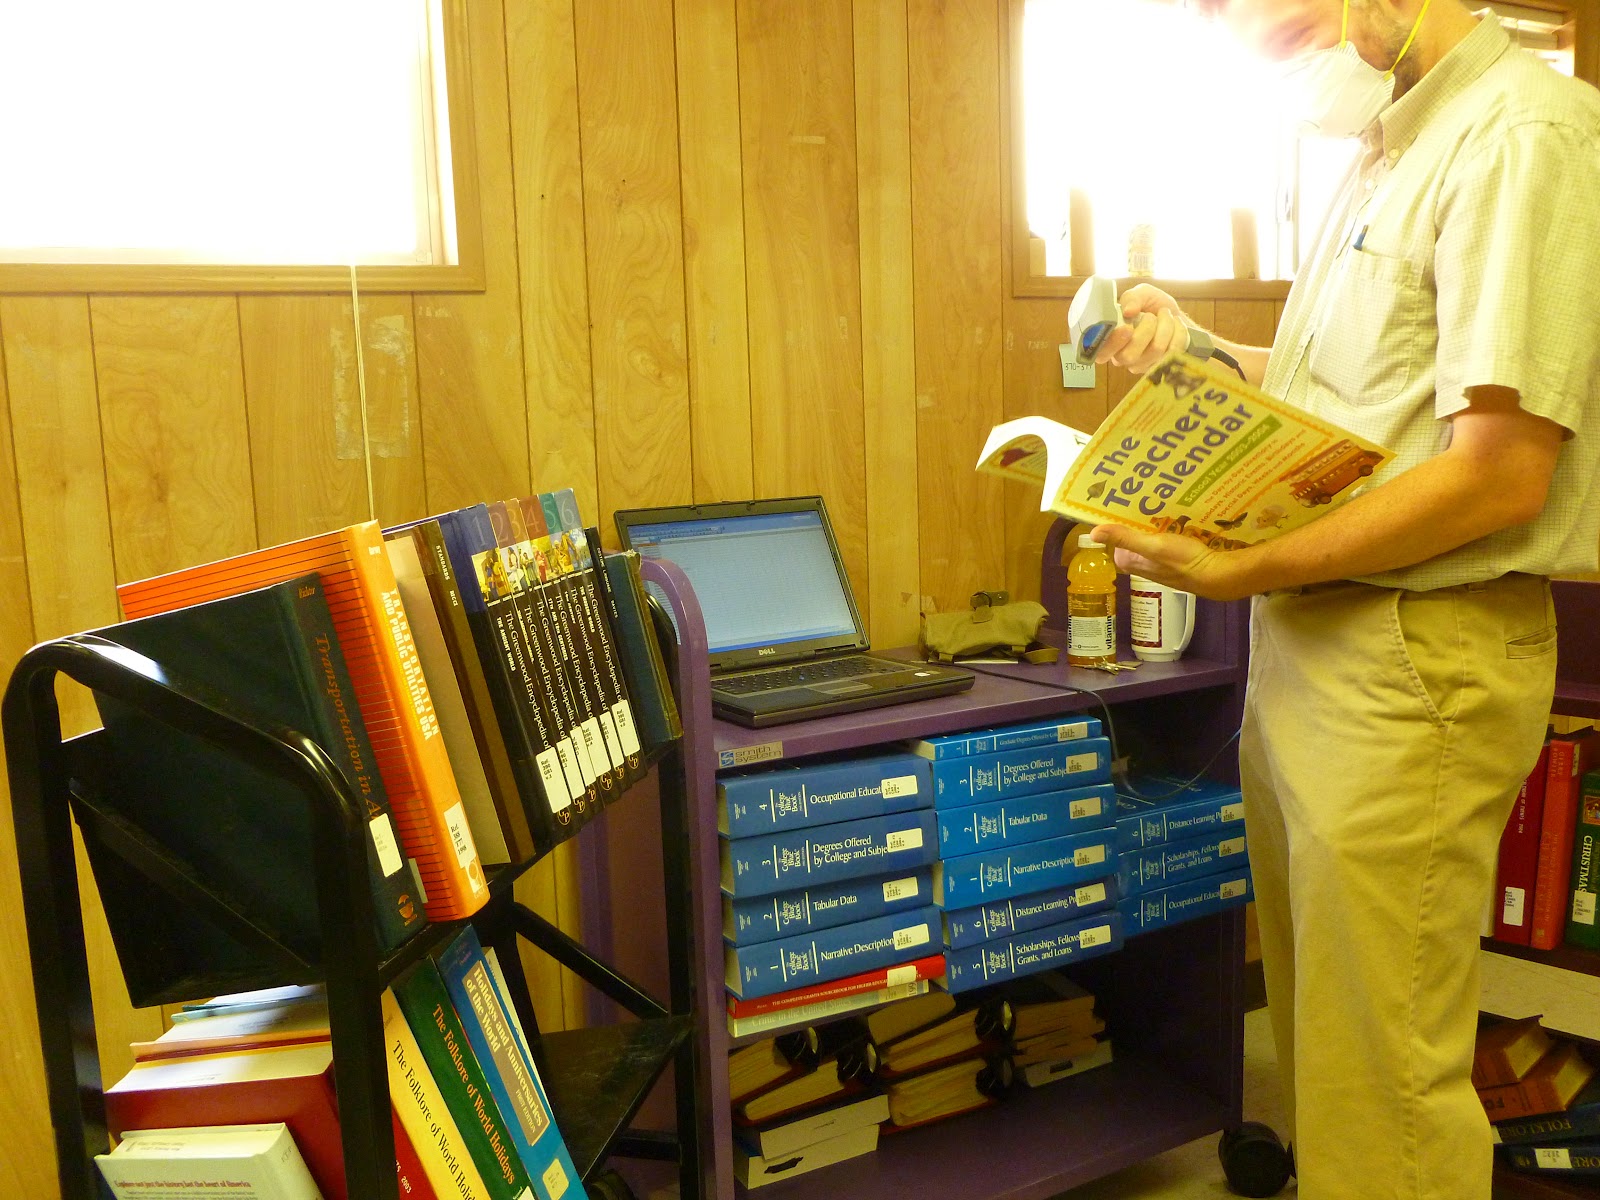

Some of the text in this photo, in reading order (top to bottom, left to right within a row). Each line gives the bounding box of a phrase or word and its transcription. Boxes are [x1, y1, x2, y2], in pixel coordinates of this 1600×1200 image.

[1093, 435, 1141, 477] The
[1103, 388, 1228, 508] Teacher's
[1139, 403, 1253, 515] Calendar
[1183, 475, 1213, 504] School
[1208, 459, 1228, 479] Year
[492, 512, 509, 542] 2
[508, 509, 521, 538] 3
[526, 507, 540, 533] 4
[543, 501, 556, 529] 5
[562, 501, 574, 525] 6
[472, 516, 486, 547] 1
[436, 545, 450, 580] STANDARDS
[499, 627, 510, 652] ANCIENT
[506, 652, 516, 672] WORLD
[554, 593, 593, 710] The Greenwood Encyclopedia
[570, 587, 610, 712] The Greenwood Encyclopedia of
[586, 582, 622, 695] The Greenwood Encyclopedia
[759, 648, 775, 656] DELL
[381, 590, 396, 616] AND
[389, 617, 409, 659] PUBLIC
[403, 661, 426, 715] UTILITIES
[418, 715, 434, 741] USA
[390, 587, 440, 737] TRANSPORTATION
[523, 605, 568, 740] The Greenwood Encyclopedia of
[536, 599, 576, 721] The Greenwood Encyclopedia
[504, 610, 552, 751] The Greenwood Encyclopedia of
[311, 632, 367, 775] Transportation
[357, 774, 374, 795] in
[736, 746, 770, 757] smith
[736, 751, 781, 763] system
[1004, 758, 1054, 775] Degrees Offered
[1004, 775, 1011, 787] by
[1013, 772, 1036, 783] College
[1038, 769, 1049, 778] and
[810, 788, 856, 804] Occupational
[1008, 812, 1048, 827] Tabular Data
[1169, 814, 1215, 830] Distance Learning
[813, 835, 871, 855] Degrees Offered
[814, 856, 823, 867] by
[825, 849, 851, 863] College
[853, 849, 866, 858] and
[1167, 848, 1200, 862] Scholarships,
[1013, 862, 1041, 875] Narrative
[1188, 859, 1197, 868] and
[1578, 835, 1593, 892] CHRISTMAS
[814, 895, 857, 911] Tabular Data
[1015, 898, 1068, 918] Distance Learning
[1168, 895, 1202, 910] Occupational
[821, 946, 853, 961] Narrative
[1016, 937, 1056, 955] Scholarships,
[1017, 946, 1072, 966] Grants, and Loans
[466, 979, 501, 1053] of the World
[787, 1007, 800, 1019] the
[801, 1001, 827, 1015] United
[473, 968, 543, 1127] Holidays and Anniversaries
[392, 1040, 407, 1070] The
[404, 1068, 432, 1122] Folklore
[430, 1121, 441, 1139] of
[436, 1134, 462, 1176] World
[432, 1004, 515, 1184] The Folklore of World Holidays
[515, 1090, 537, 1134] FIRST EDITION
[401, 1177, 411, 1193] 2003
